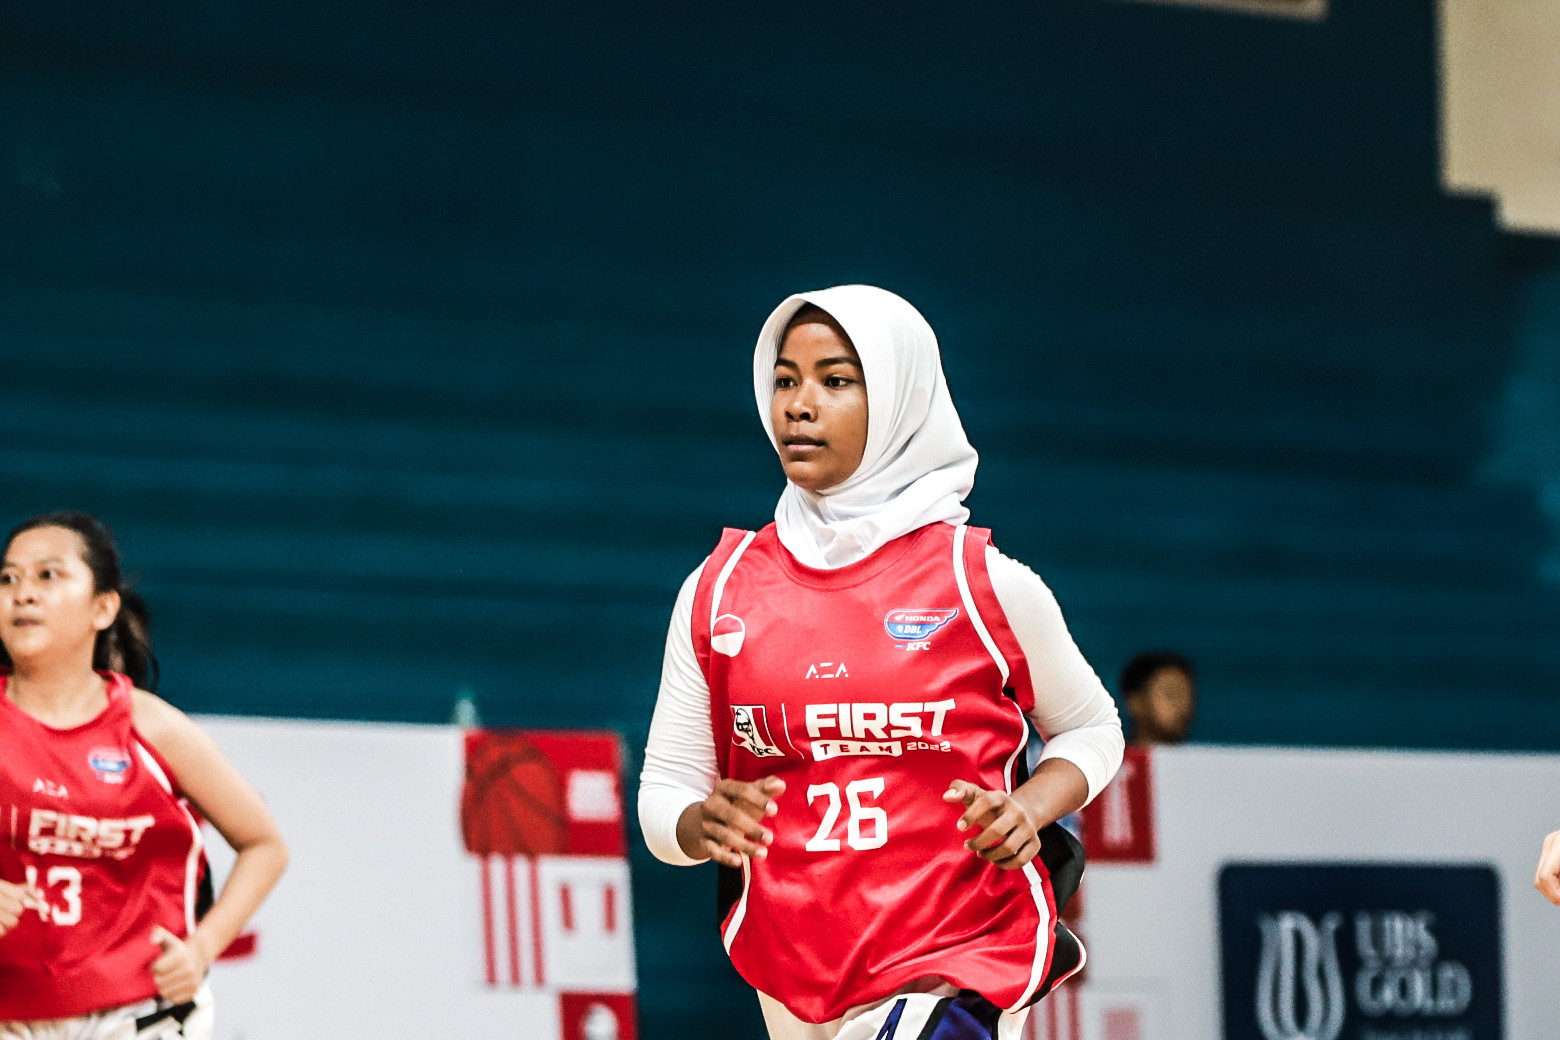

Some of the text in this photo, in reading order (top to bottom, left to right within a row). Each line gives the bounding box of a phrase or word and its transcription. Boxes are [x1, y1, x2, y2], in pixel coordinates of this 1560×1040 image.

[903, 625, 922, 634] DBL
[906, 641, 931, 651] KFC
[805, 699, 956, 739] FIRST
[817, 740, 952, 758] TEAM 2022
[29, 807, 155, 848] FIRST
[805, 777, 889, 852] 26
